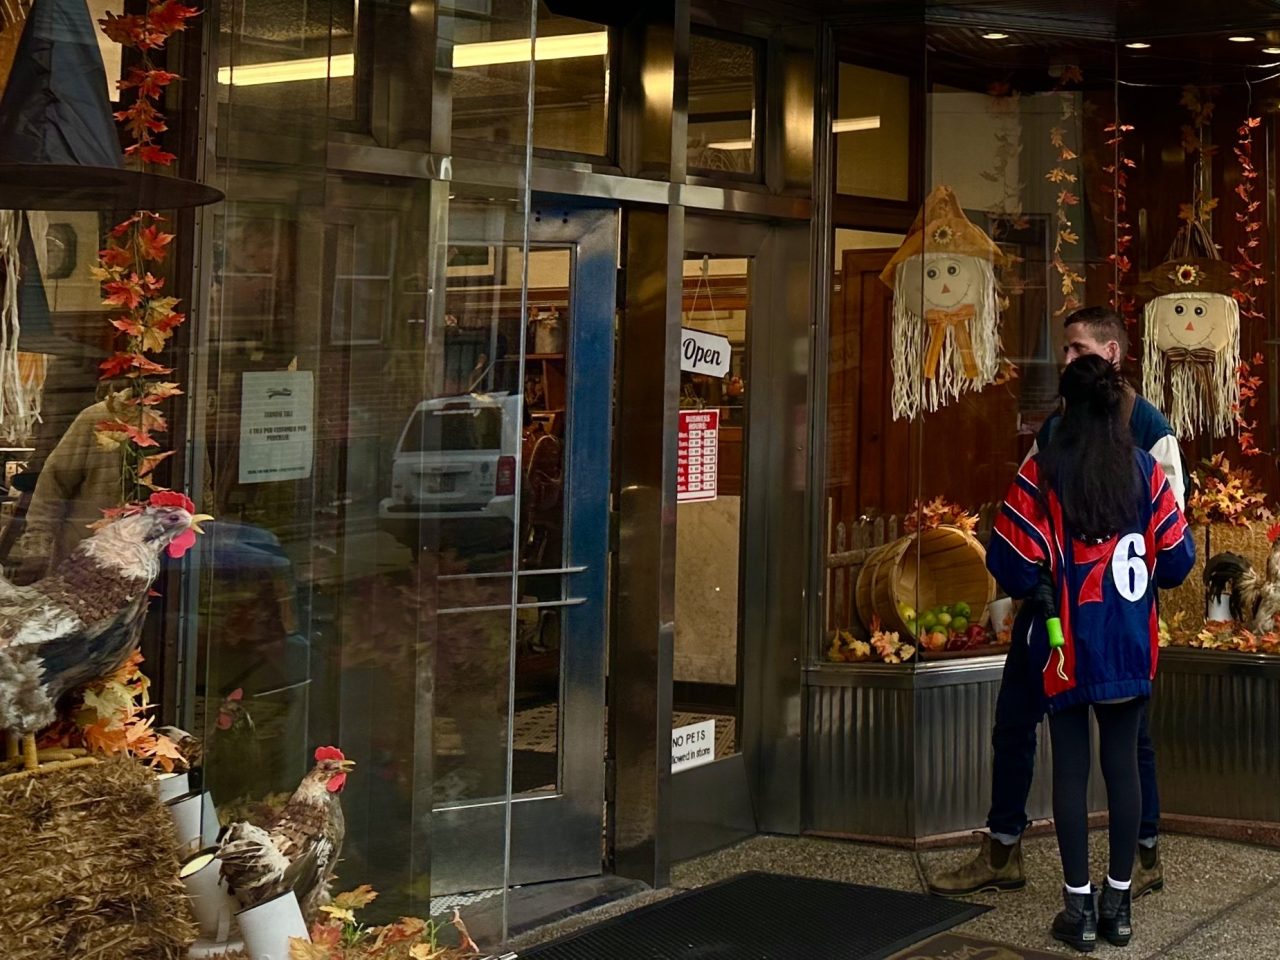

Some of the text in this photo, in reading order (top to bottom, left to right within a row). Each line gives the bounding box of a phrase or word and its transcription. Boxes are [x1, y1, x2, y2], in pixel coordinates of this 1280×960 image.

[682, 337, 721, 368] Open
[1072, 531, 1149, 607] 76
[672, 729, 706, 748] NO PETS
